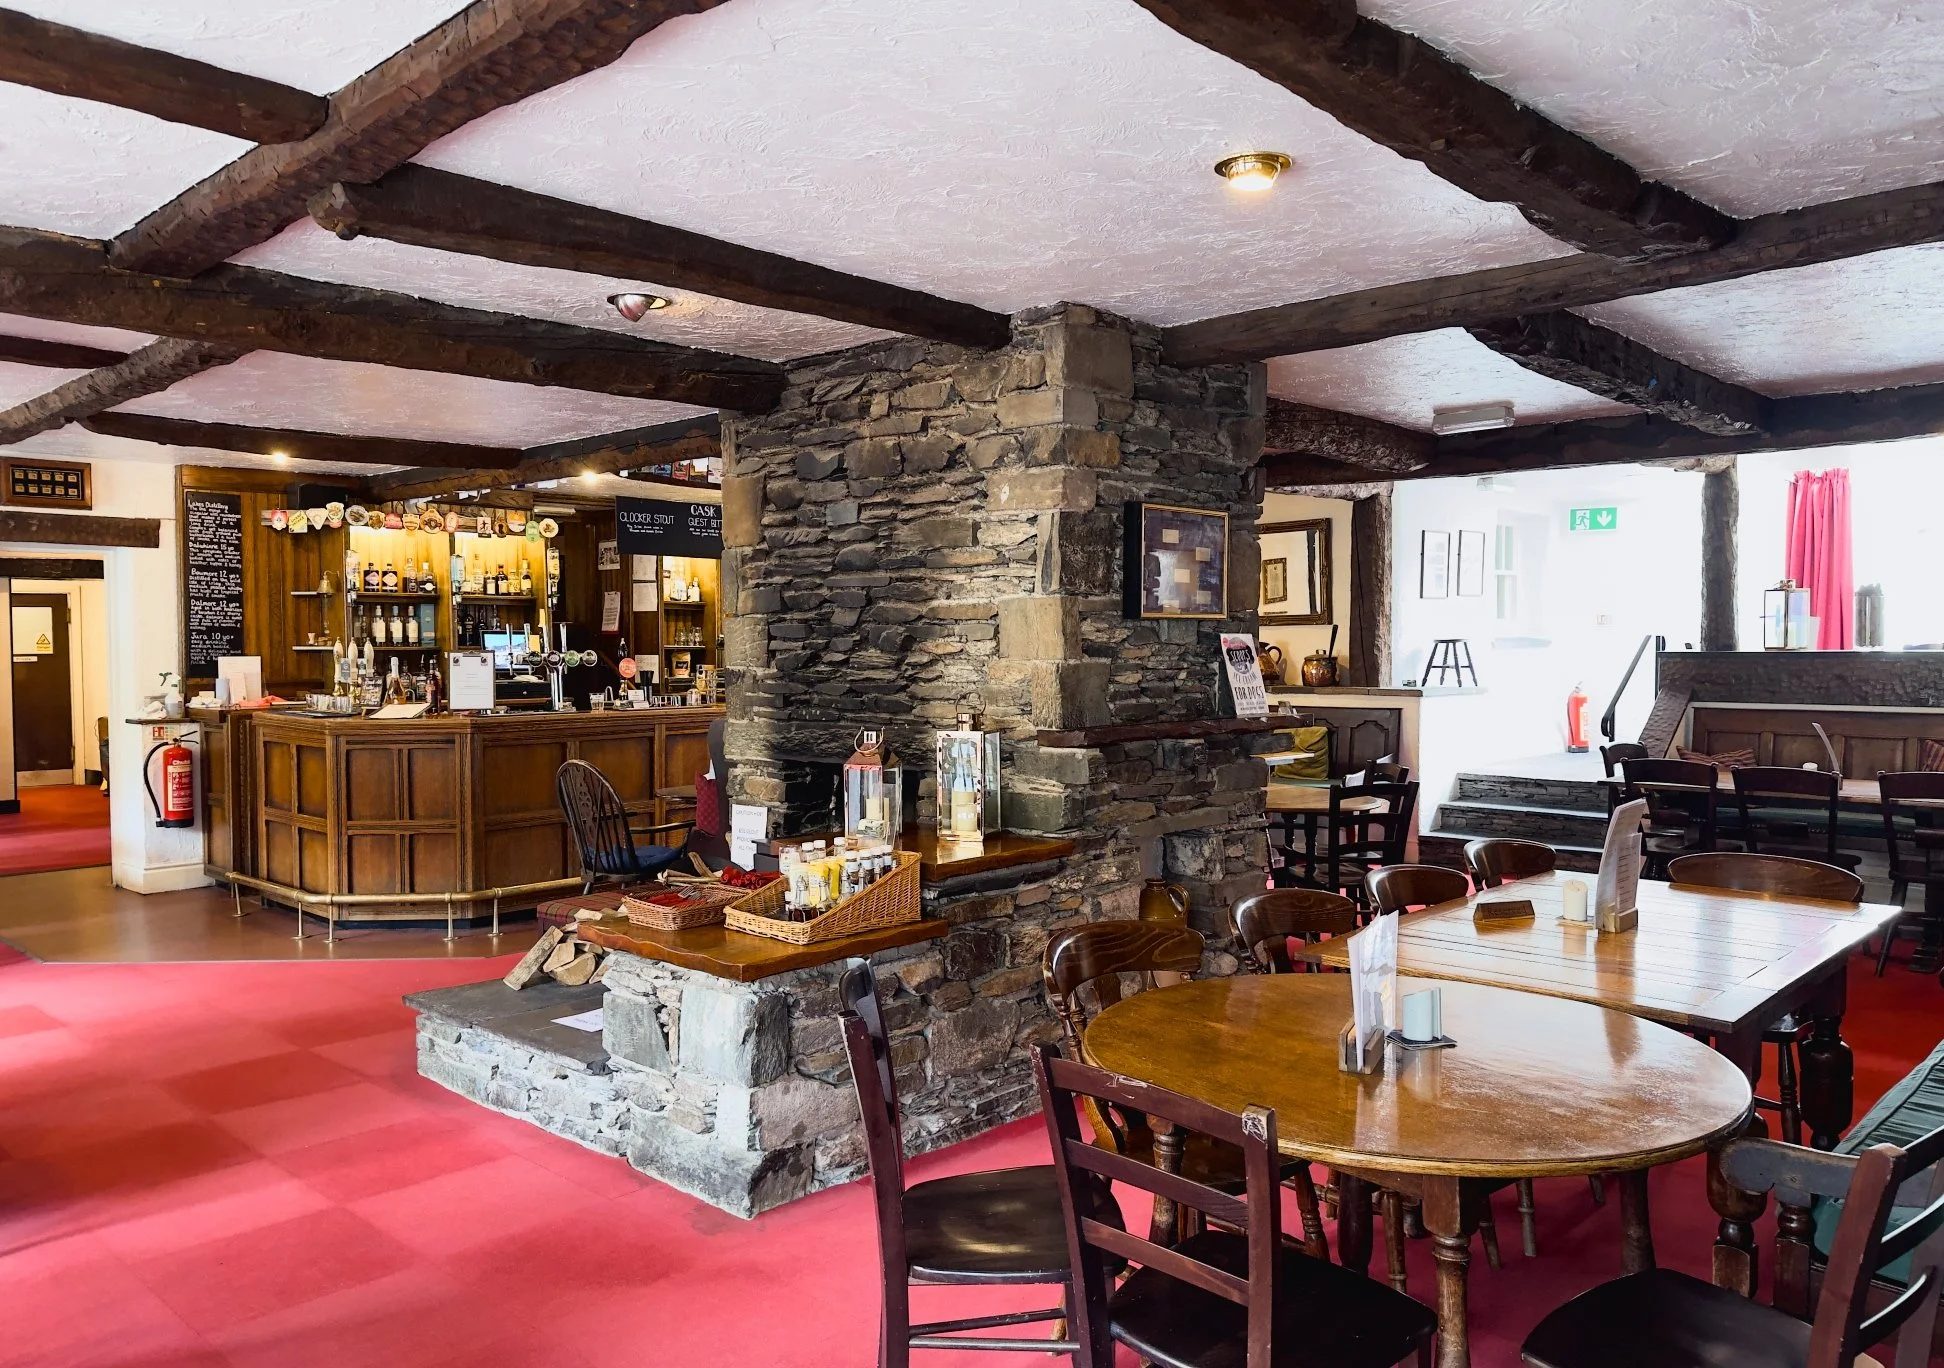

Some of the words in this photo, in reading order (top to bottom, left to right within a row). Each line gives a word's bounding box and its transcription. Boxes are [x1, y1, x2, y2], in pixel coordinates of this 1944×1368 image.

[690, 504, 717, 518] CASK
[654, 514, 674, 524] STOUT
[192, 568, 218, 577] Bowmore
[220, 570, 228, 578] 12
[190, 599, 216, 607] Dalmore
[190, 632, 208, 640] Jura
[1234, 686, 1247, 700] FOR
[1248, 686, 1264, 700] DOGS
